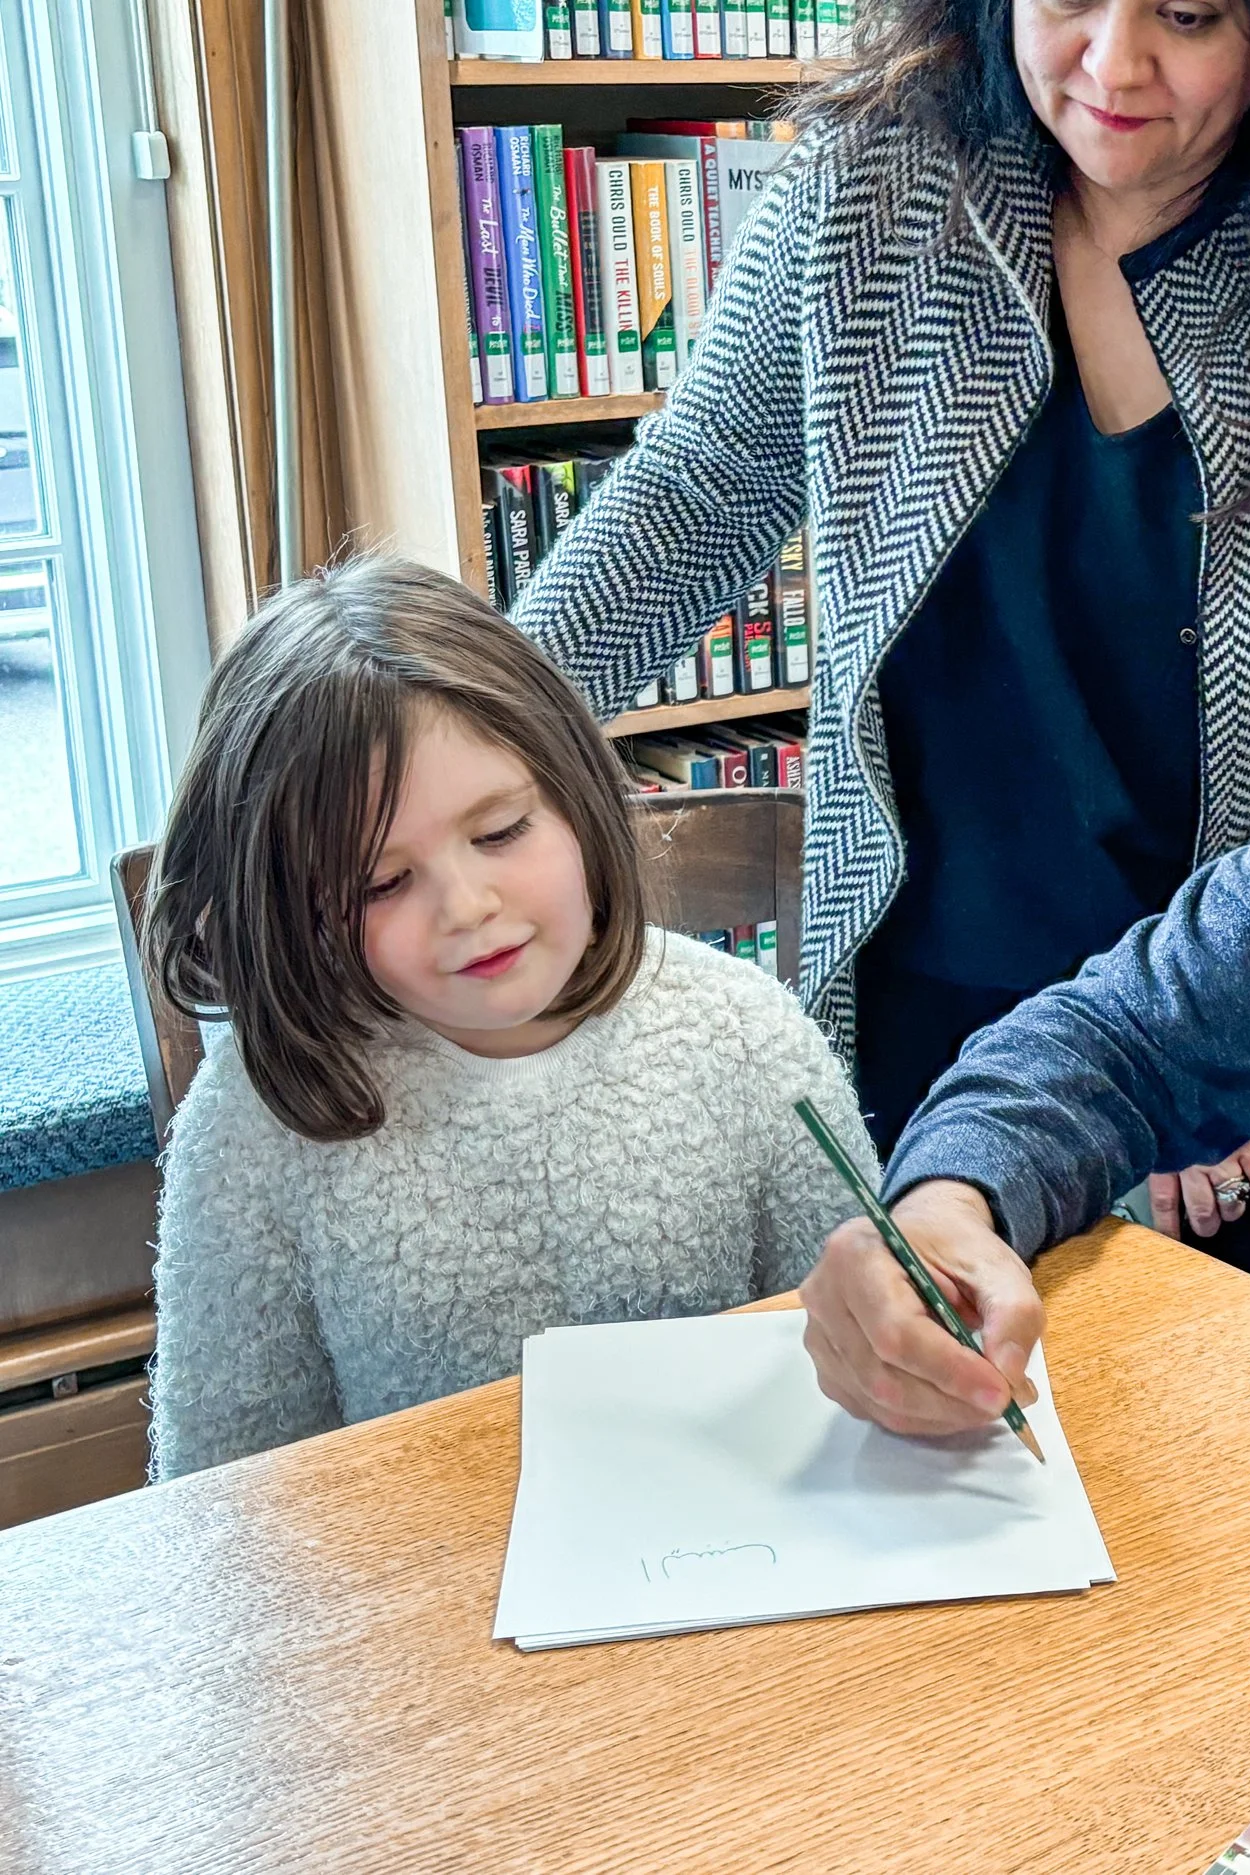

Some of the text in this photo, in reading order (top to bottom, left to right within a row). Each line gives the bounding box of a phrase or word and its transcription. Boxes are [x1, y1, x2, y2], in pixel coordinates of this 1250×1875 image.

[471, 144, 484, 182] OSMAN
[511, 137, 522, 176] OSMAN
[519, 136, 532, 176] RICHARD
[704, 143, 716, 155] A
[679, 169, 693, 205] CHRIS
[705, 158, 718, 201] QUIET
[648, 186, 666, 300] THE BOOK OF SOULS
[680, 210, 695, 242] OULD
[708, 206, 721, 263] TEACHER
[479, 198, 505, 326] The Last DEVIL to
[514, 208, 538, 320] The Man Who Died
[549, 184, 573, 333] The Bullet That MISS
[609, 170, 634, 332] CHRIS OULD THE KILLIN
[683, 251, 697, 274] THE
[686, 277, 700, 317] BLOOD
[554, 492, 570, 528] SARA
[510, 510, 532, 589] SARA PARE
[783, 590, 805, 626] FALLO
